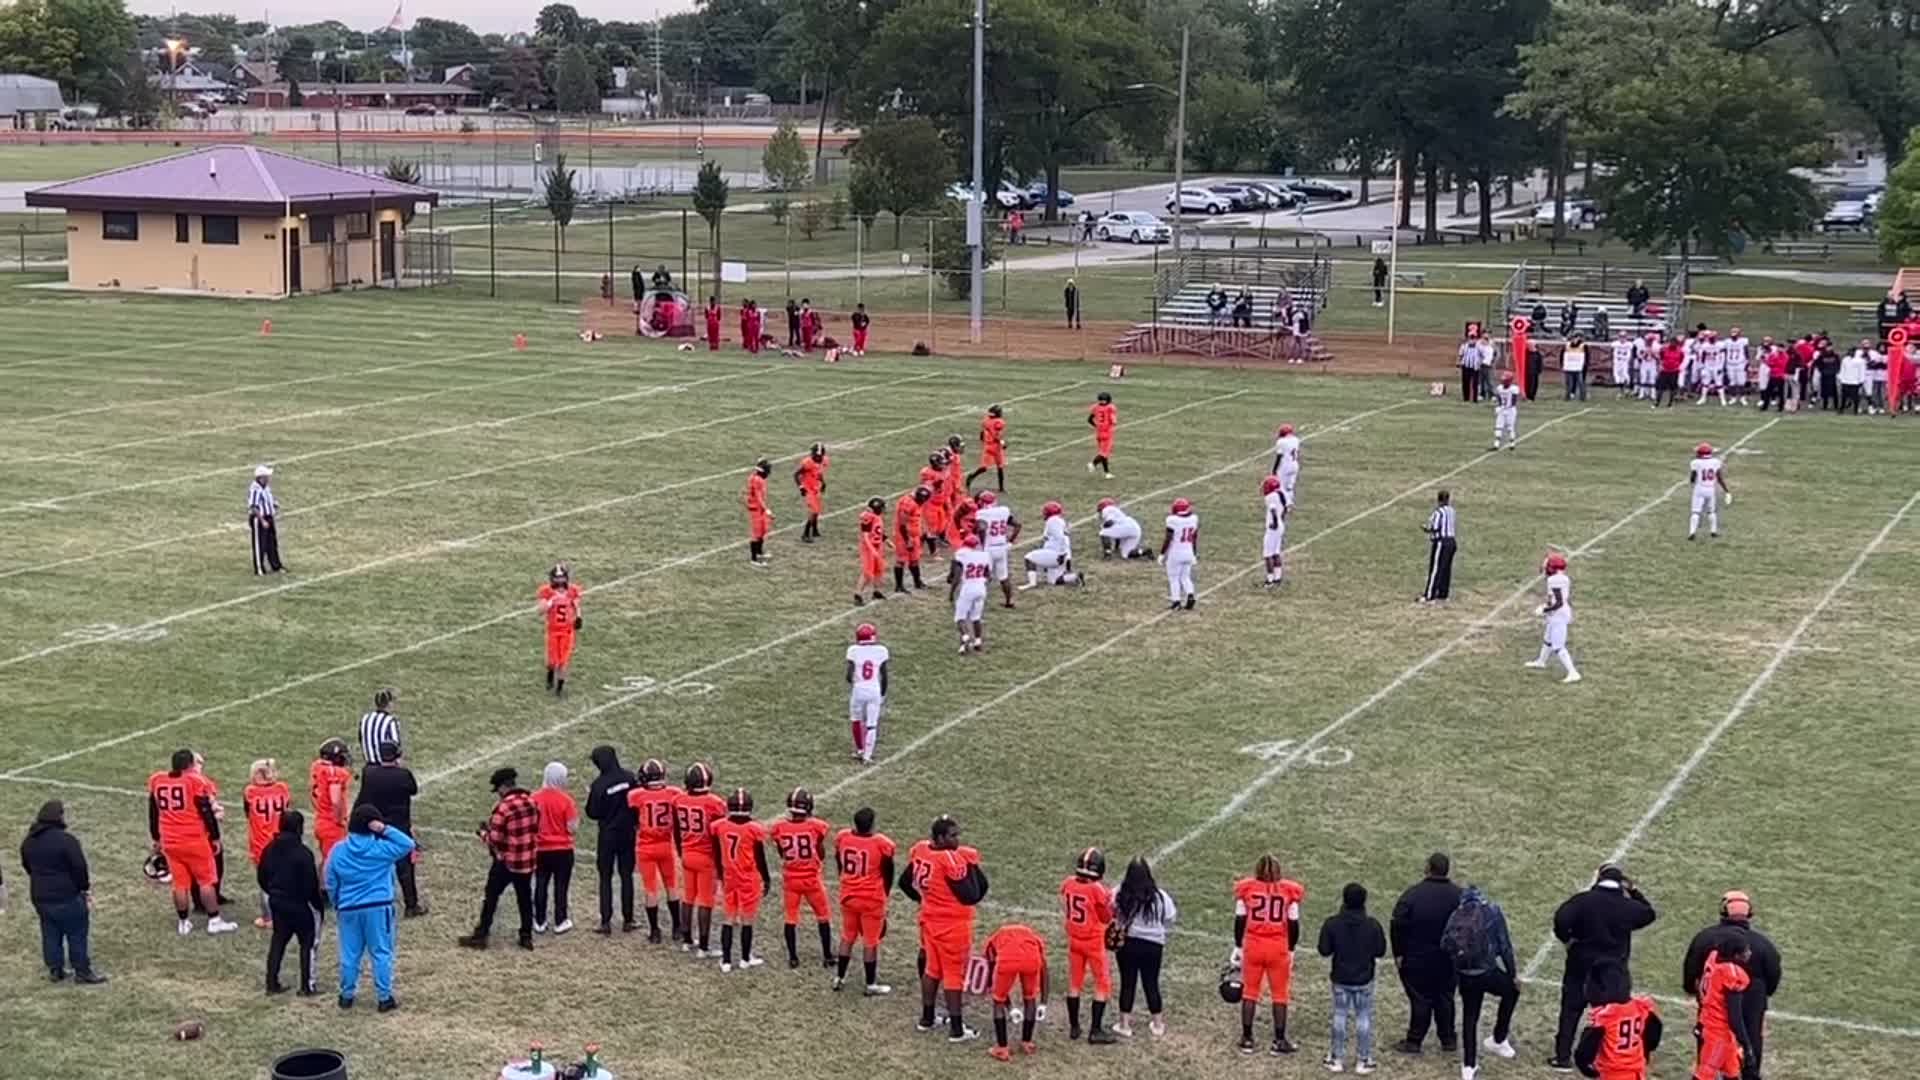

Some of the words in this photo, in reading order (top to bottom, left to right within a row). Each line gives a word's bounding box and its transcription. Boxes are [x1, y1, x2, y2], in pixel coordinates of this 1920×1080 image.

[862, 659, 873, 680] 6
[156, 785, 185, 812] 69
[255, 795, 284, 822] 44
[645, 801, 670, 828] 12
[677, 806, 705, 833] 33
[726, 834, 739, 860] 7
[780, 834, 812, 861] 28
[843, 848, 867, 877] 61
[1065, 892, 1086, 923] 15
[1250, 894, 1285, 923] 20
[1616, 1015, 1643, 1051] 99
